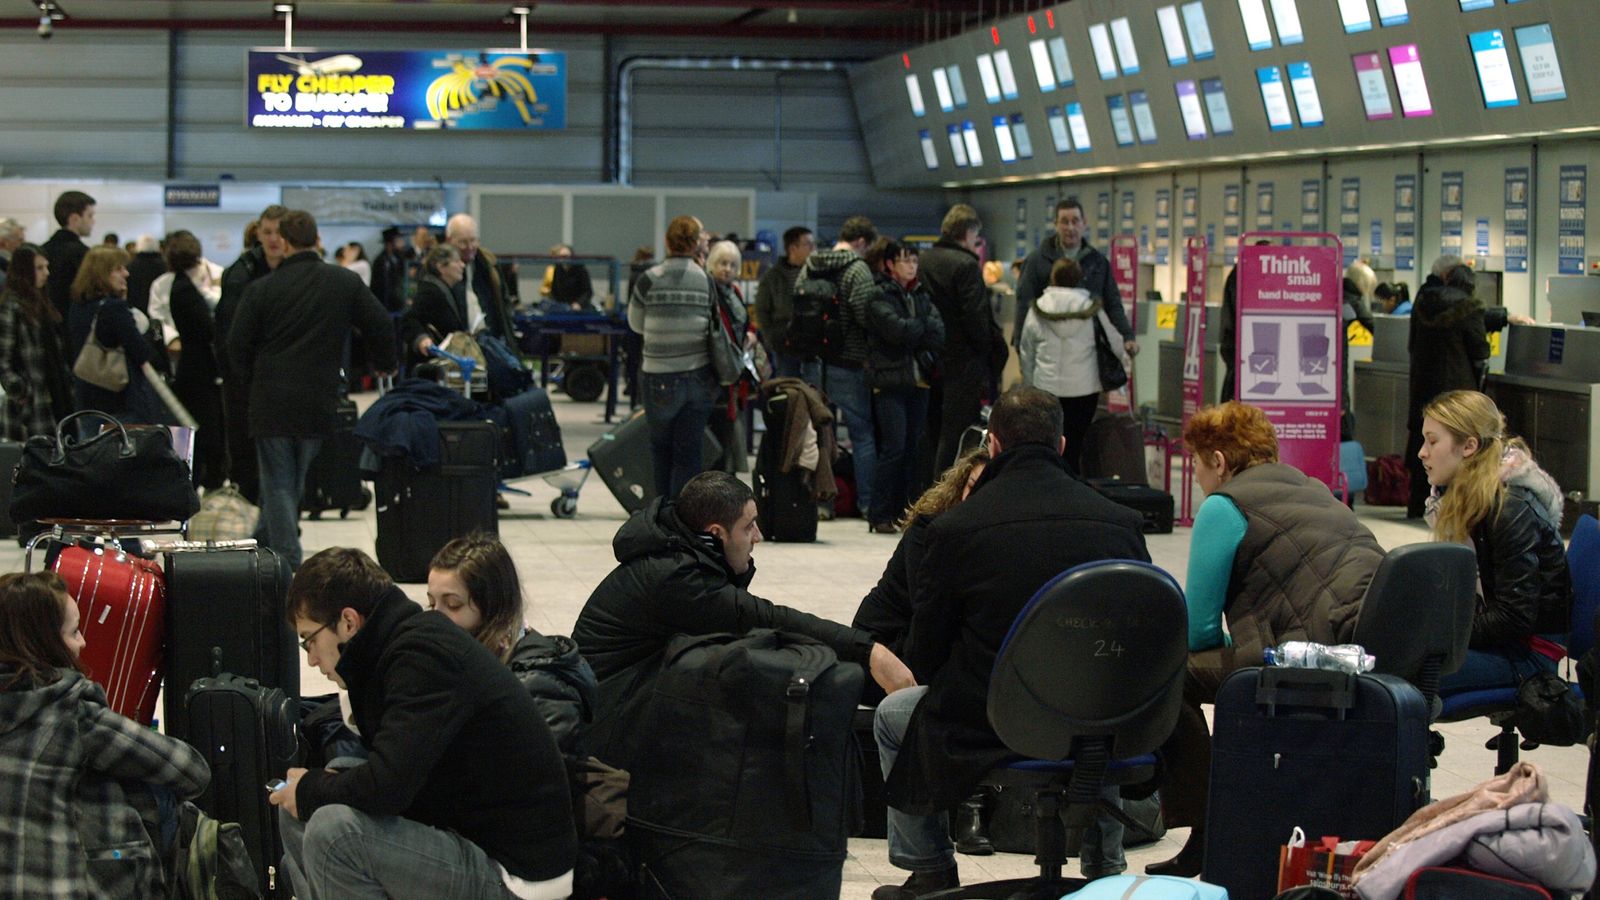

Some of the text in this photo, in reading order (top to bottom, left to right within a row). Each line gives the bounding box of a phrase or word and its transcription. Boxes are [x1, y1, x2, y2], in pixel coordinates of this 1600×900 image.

[258, 75, 395, 94] FLY CHEAPER
[262, 93, 292, 112] TO
[1259, 254, 1311, 274] Think
[1287, 273, 1320, 286] small
[1258, 290, 1322, 302] hand baggage
[1094, 639, 1125, 658] 24
